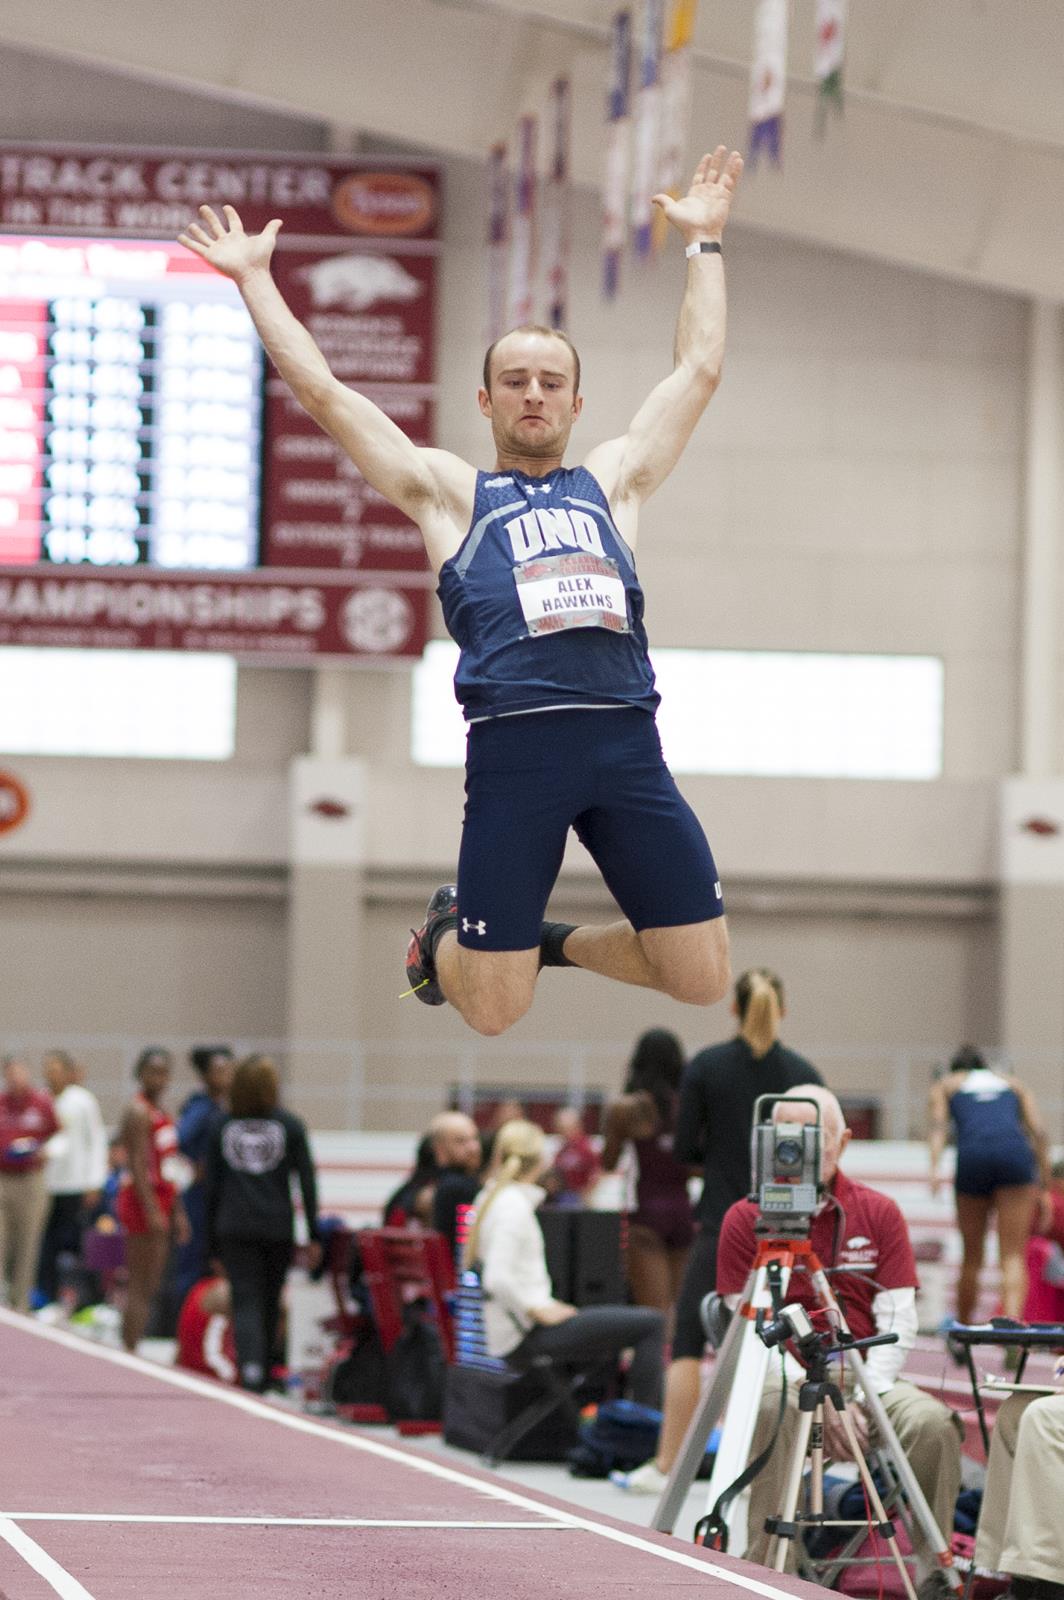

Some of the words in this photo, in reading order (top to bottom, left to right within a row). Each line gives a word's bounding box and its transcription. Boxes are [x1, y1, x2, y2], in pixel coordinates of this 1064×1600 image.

[1, 156, 146, 202] TRACK
[154, 160, 332, 206] CENTER
[558, 577, 593, 593] ALEX
[542, 594, 613, 613] HAWKINS
